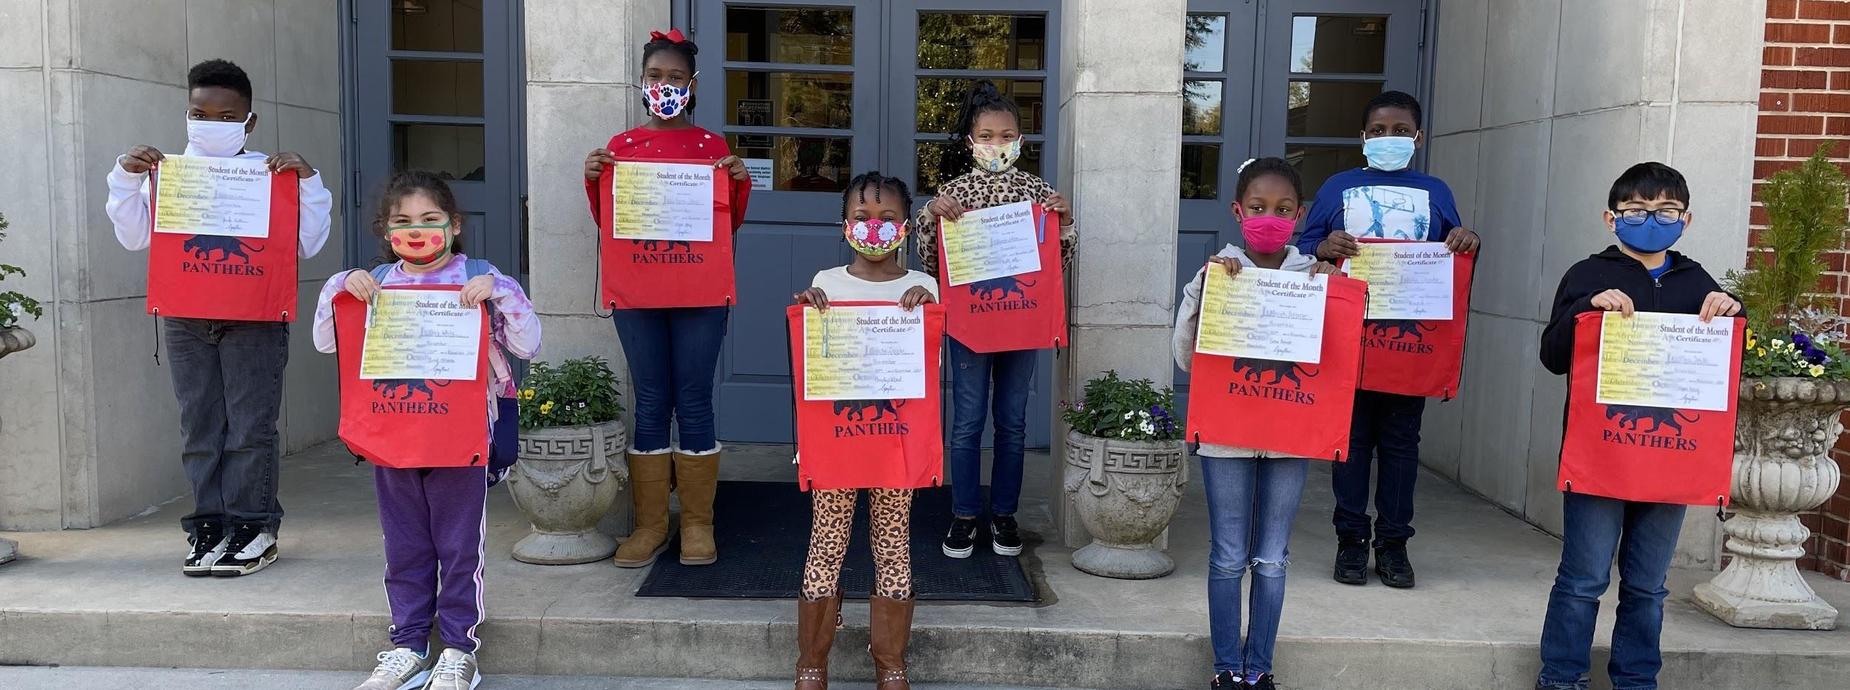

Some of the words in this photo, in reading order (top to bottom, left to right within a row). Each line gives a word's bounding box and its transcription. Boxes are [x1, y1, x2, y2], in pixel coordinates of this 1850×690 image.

[208, 166, 230, 174] Student
[232, 167, 238, 175] of
[981, 214, 998, 224] Student
[1015, 209, 1030, 217] Month
[993, 220, 1020, 228] Certificate
[633, 254, 703, 263] PANTHERS
[183, 262, 264, 275] PANTHERS
[1257, 279, 1281, 288] Student
[1282, 281, 1290, 289] of
[1291, 281, 1300, 290] the
[1302, 283, 1323, 292] Month
[970, 300, 1037, 313] PANTHERS
[856, 317, 880, 325] Student
[881, 317, 889, 325] of
[889, 317, 899, 325] the
[1660, 324, 1685, 333] Student
[1687, 325, 1694, 334] of
[1695, 326, 1705, 334] the
[1707, 327, 1729, 336] Month
[1228, 382, 1316, 405] PANTHERS
[372, 401, 448, 415] PANTHERS
[1603, 430, 1697, 451] PANTHERS
